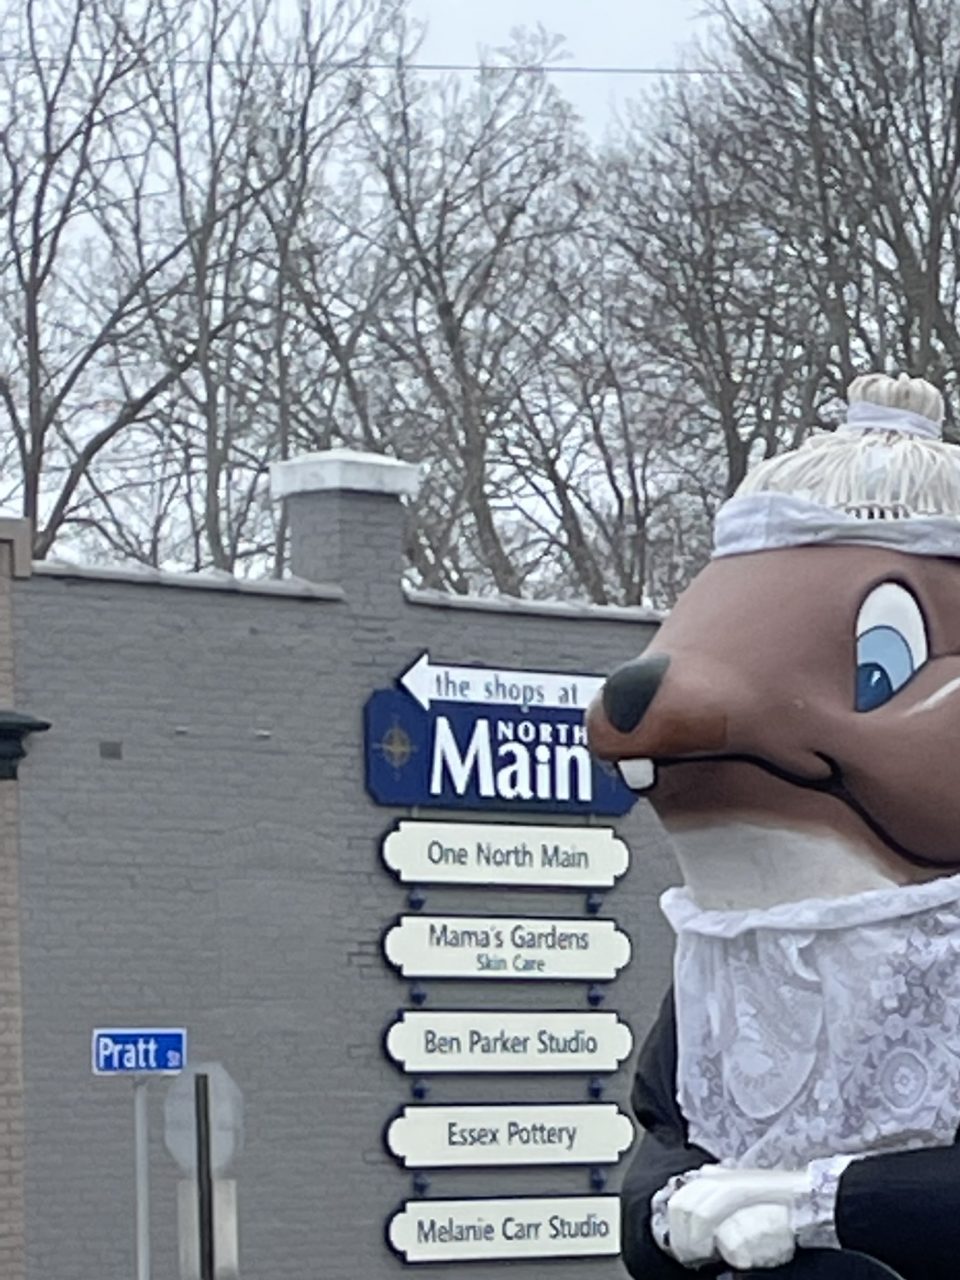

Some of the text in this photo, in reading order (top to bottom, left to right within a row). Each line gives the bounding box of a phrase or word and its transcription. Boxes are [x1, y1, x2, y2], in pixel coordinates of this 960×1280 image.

[436, 671, 578, 706] the shops at
[497, 721, 588, 744] NORTH
[430, 716, 592, 800] Main
[427, 840, 589, 869] One North Main
[429, 923, 589, 950] Mama's Gardens
[476, 953, 545, 972] Skin Care
[99, 1037, 157, 1068] Pratt
[424, 1029, 598, 1053] Ben Parker Studio
[448, 1122, 577, 1150] Essex Pottery
[417, 1213, 609, 1244] Melanie Carr Studio
